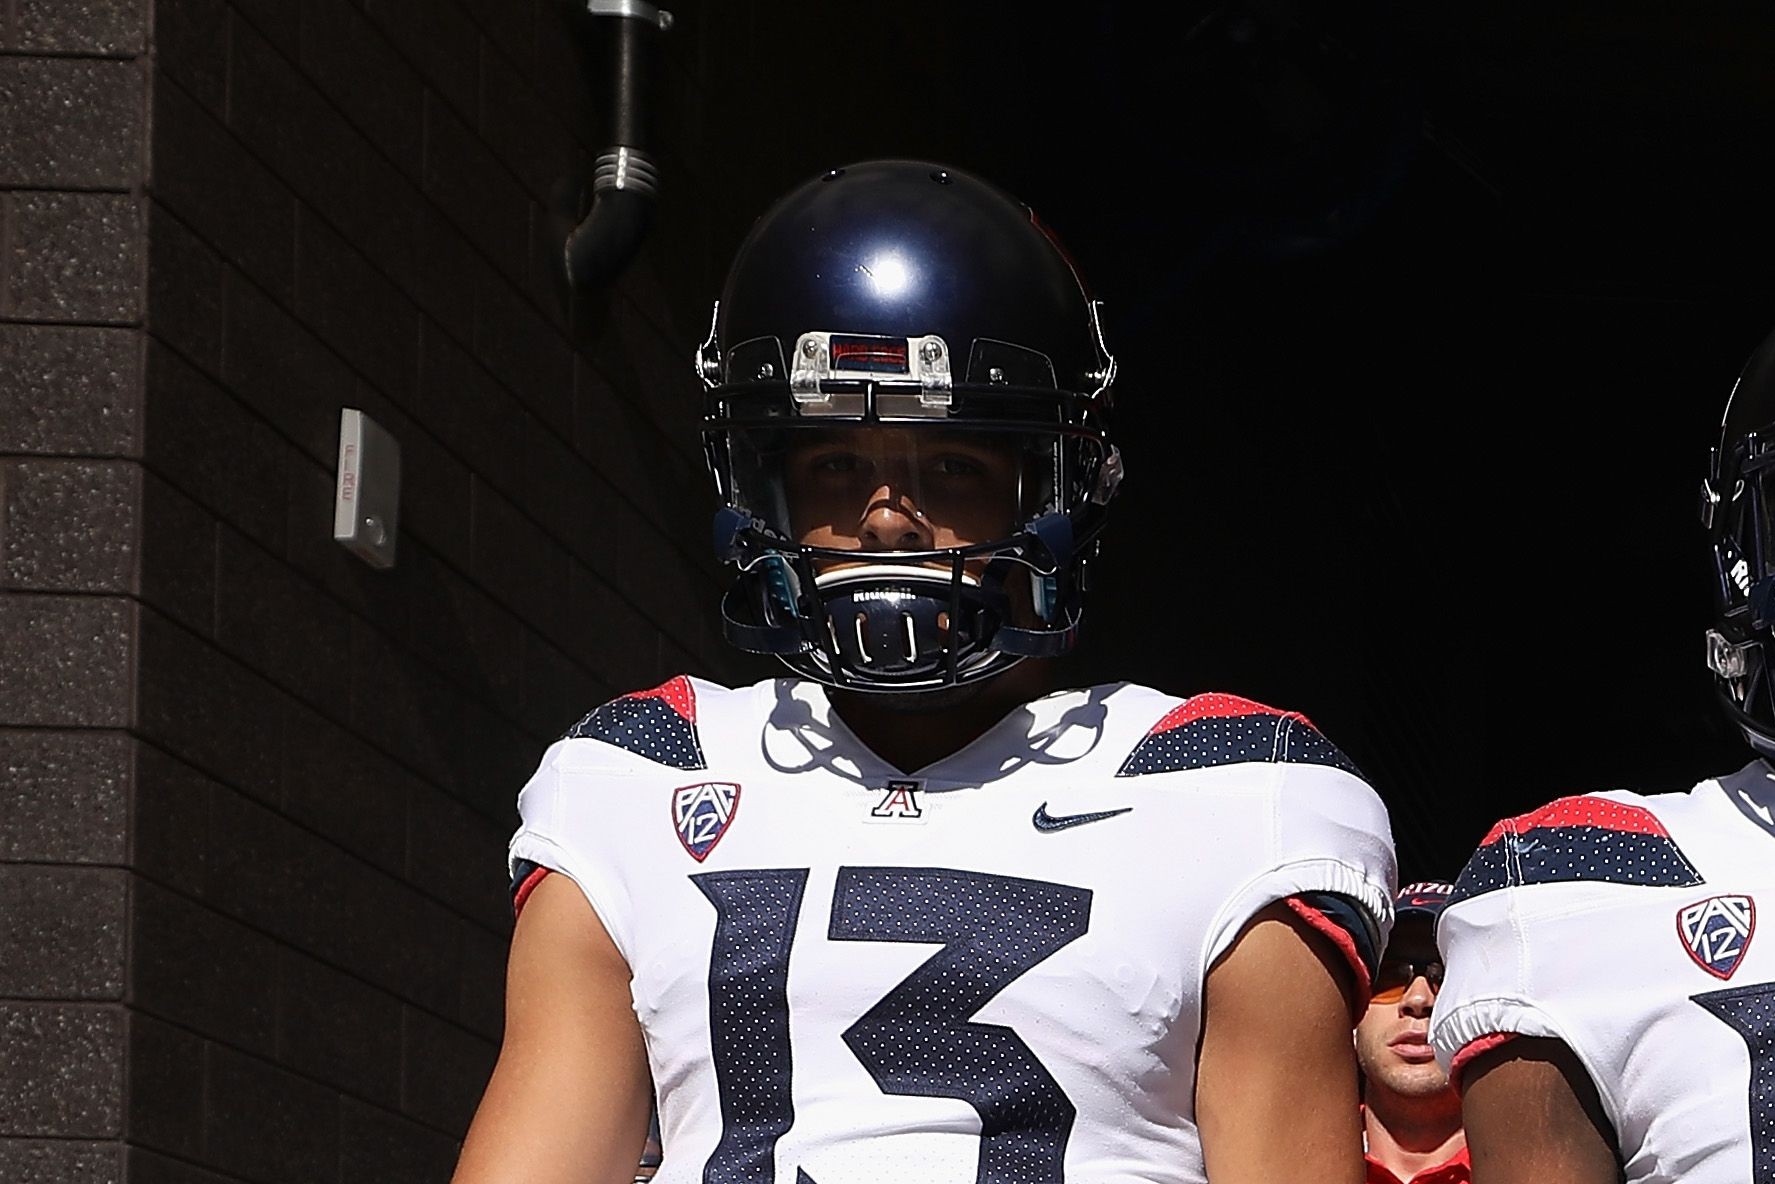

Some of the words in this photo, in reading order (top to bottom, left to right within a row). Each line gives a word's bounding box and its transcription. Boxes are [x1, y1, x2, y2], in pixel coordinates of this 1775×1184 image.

[676, 784, 738, 833] PAC
[871, 780, 922, 818] A
[688, 812, 719, 845] 12
[1681, 897, 1751, 952] PAC
[1702, 926, 1740, 964] 12
